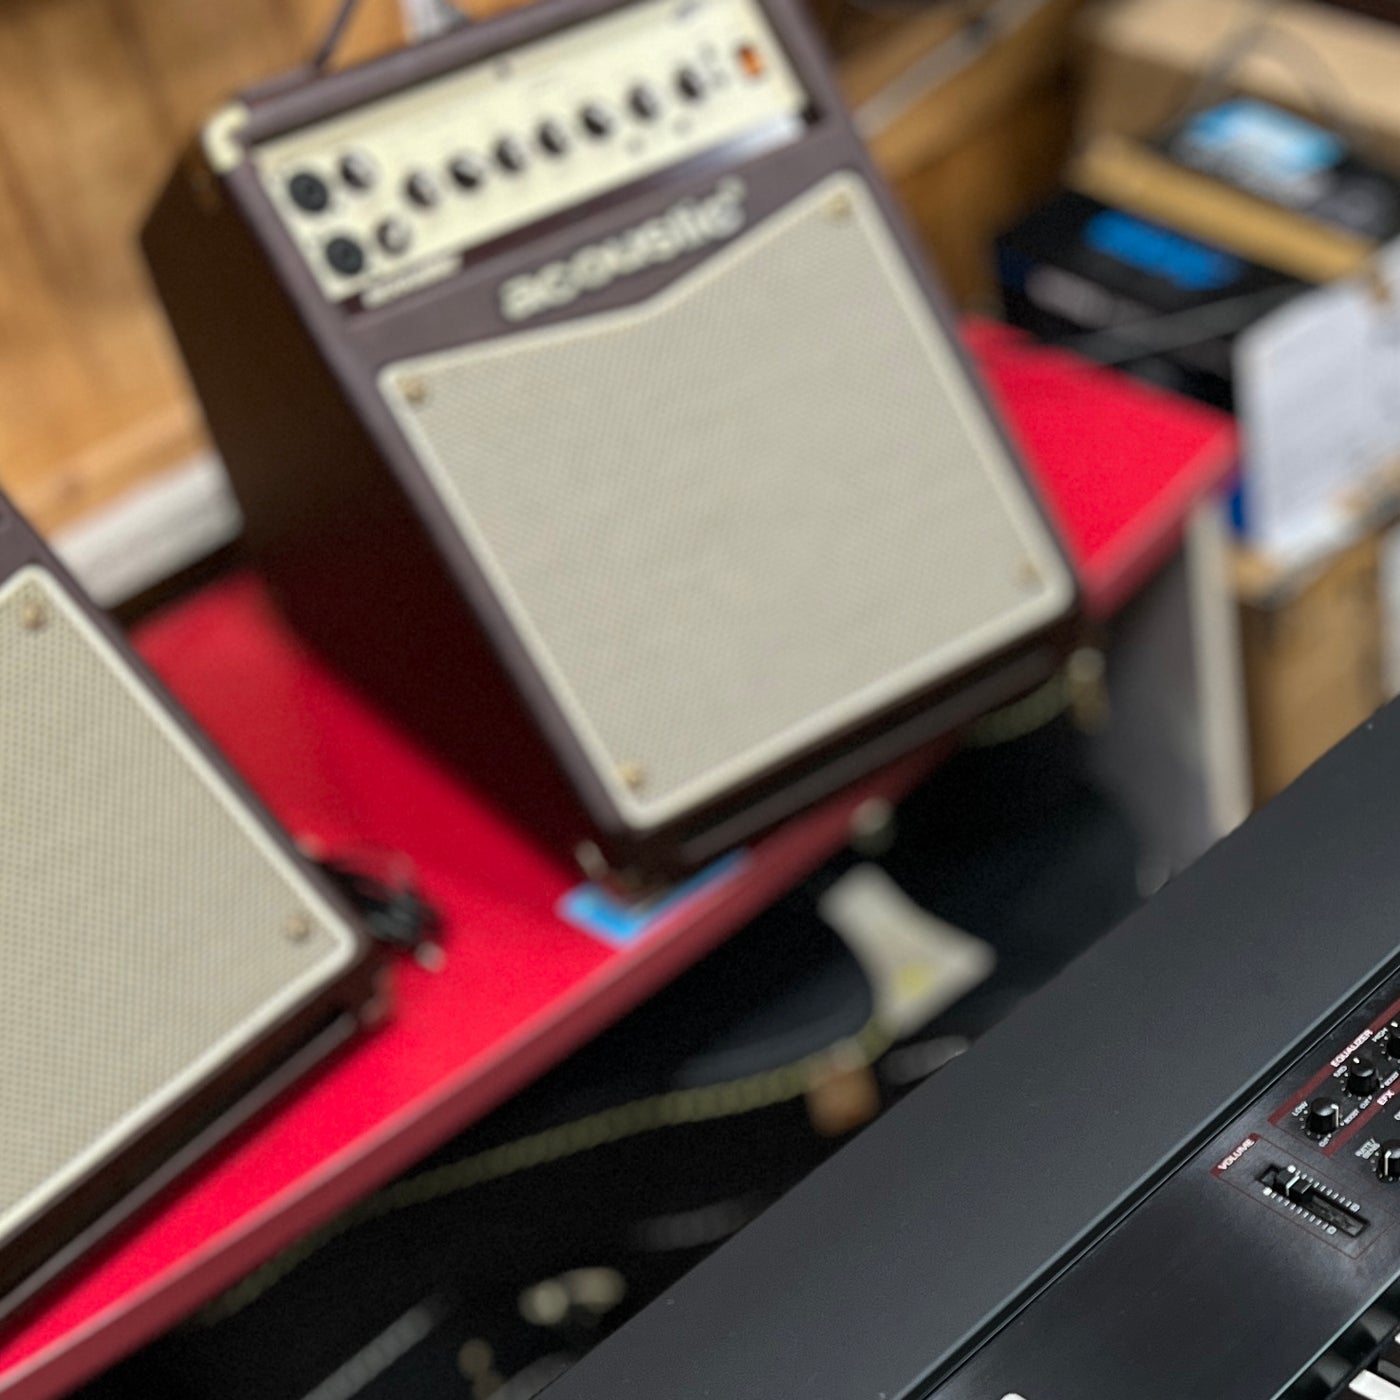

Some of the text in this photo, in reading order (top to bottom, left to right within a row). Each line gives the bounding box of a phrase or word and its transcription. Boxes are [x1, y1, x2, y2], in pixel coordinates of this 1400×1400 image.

[1330, 1028, 1374, 1068] EQUALIZER
[1291, 1100, 1309, 1117] LOW
[1376, 1089, 1395, 1106] EFX
[1217, 1138, 1255, 1170] VOLUME
